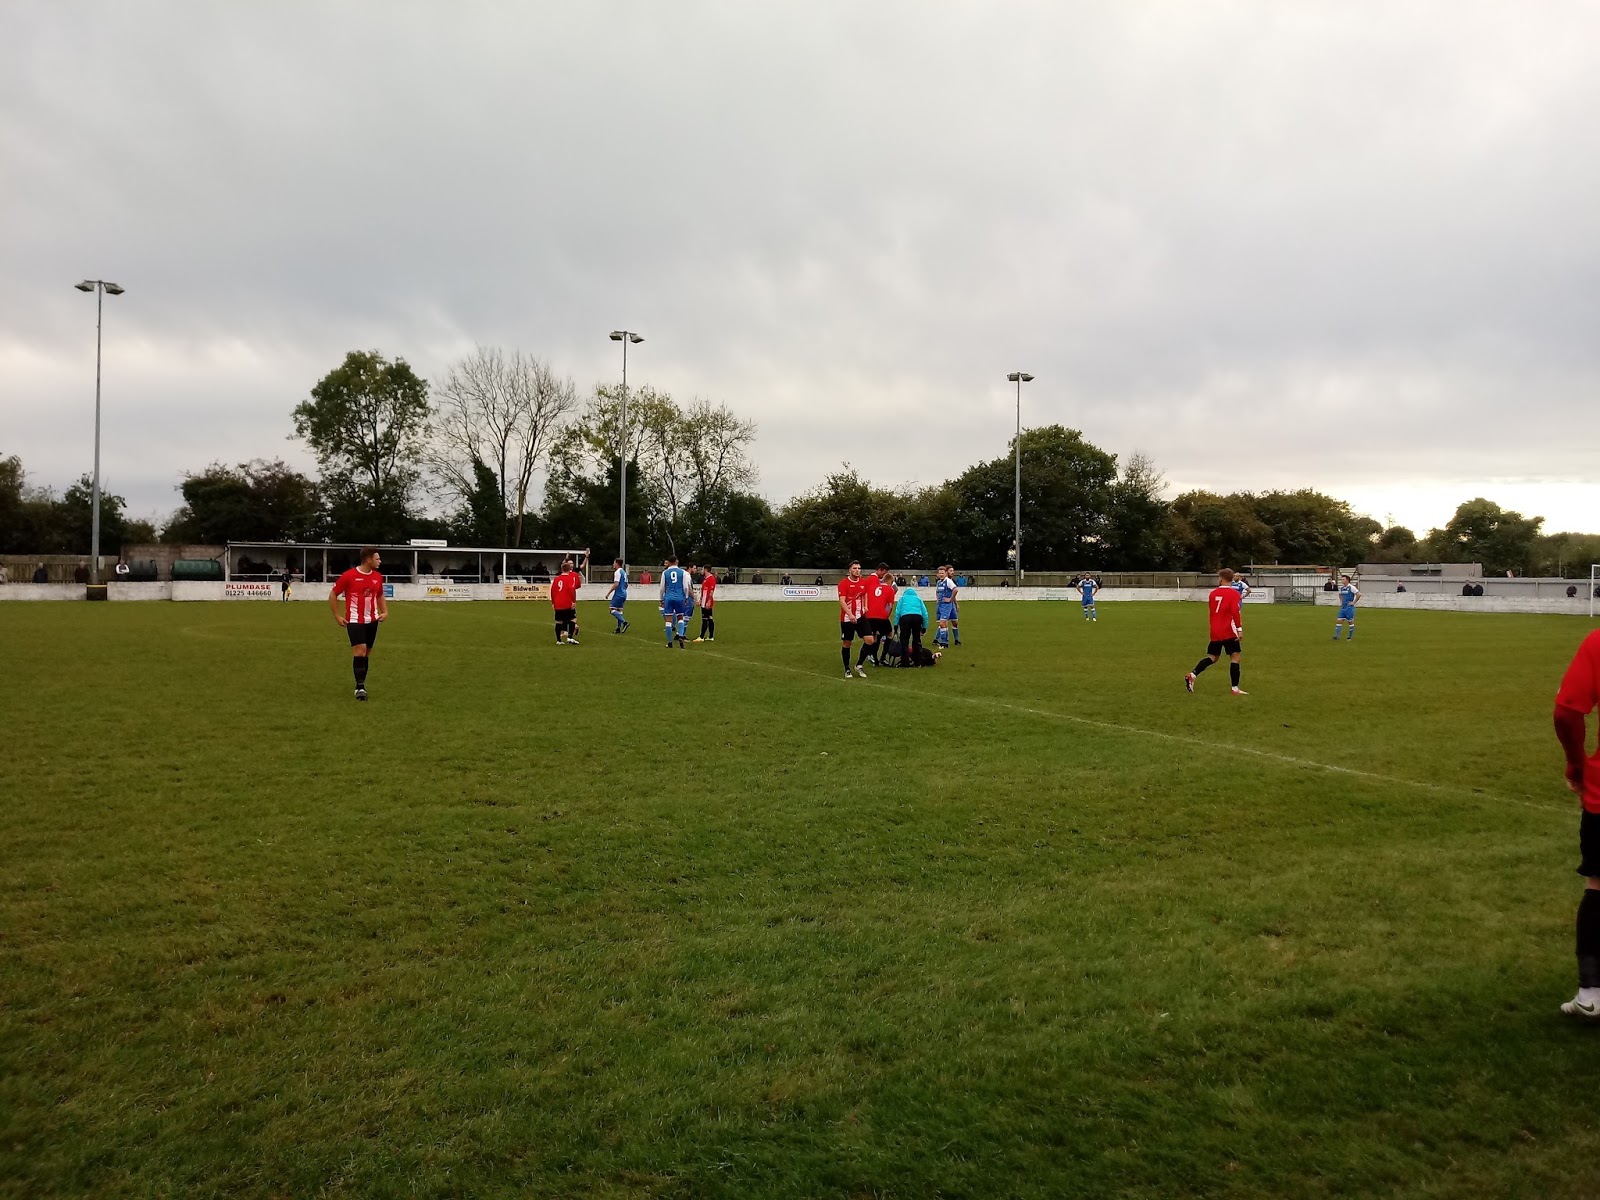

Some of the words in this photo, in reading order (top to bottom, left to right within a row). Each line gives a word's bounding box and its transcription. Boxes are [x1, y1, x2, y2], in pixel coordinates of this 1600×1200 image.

[670, 571, 678, 583] 9
[557, 580, 563, 592] 9
[874, 586, 883, 597] 6
[1214, 596, 1223, 613] 7
